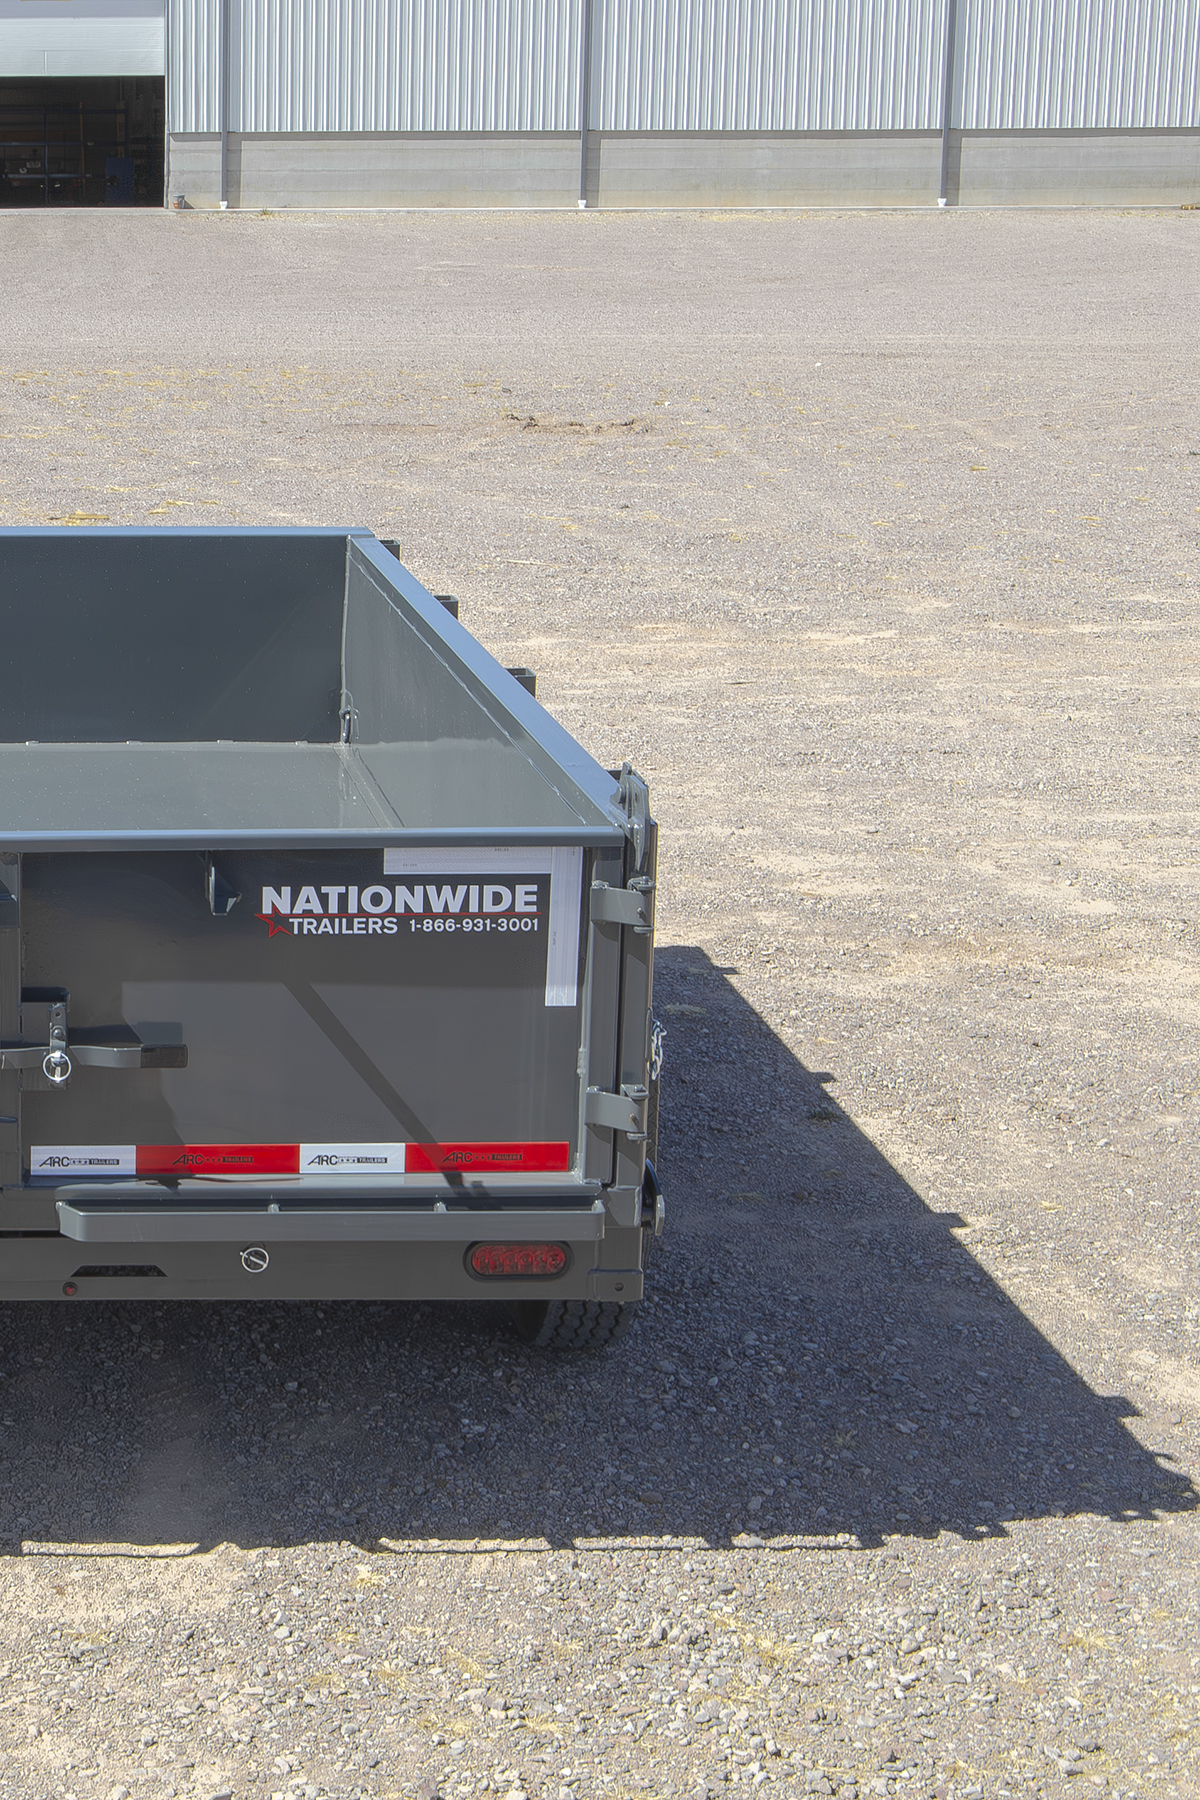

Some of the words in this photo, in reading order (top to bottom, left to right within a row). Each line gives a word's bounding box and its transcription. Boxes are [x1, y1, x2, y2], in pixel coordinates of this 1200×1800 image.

[262, 884, 538, 914] NATIONWIDE
[289, 917, 398, 934] TRAILERS
[409, 918, 539, 932] 1-866-931-3001
[39, 1156, 70, 1168] ARC
[172, 1154, 204, 1165] ARC
[307, 1154, 338, 1166] ARC
[442, 1151, 473, 1163] ARC
